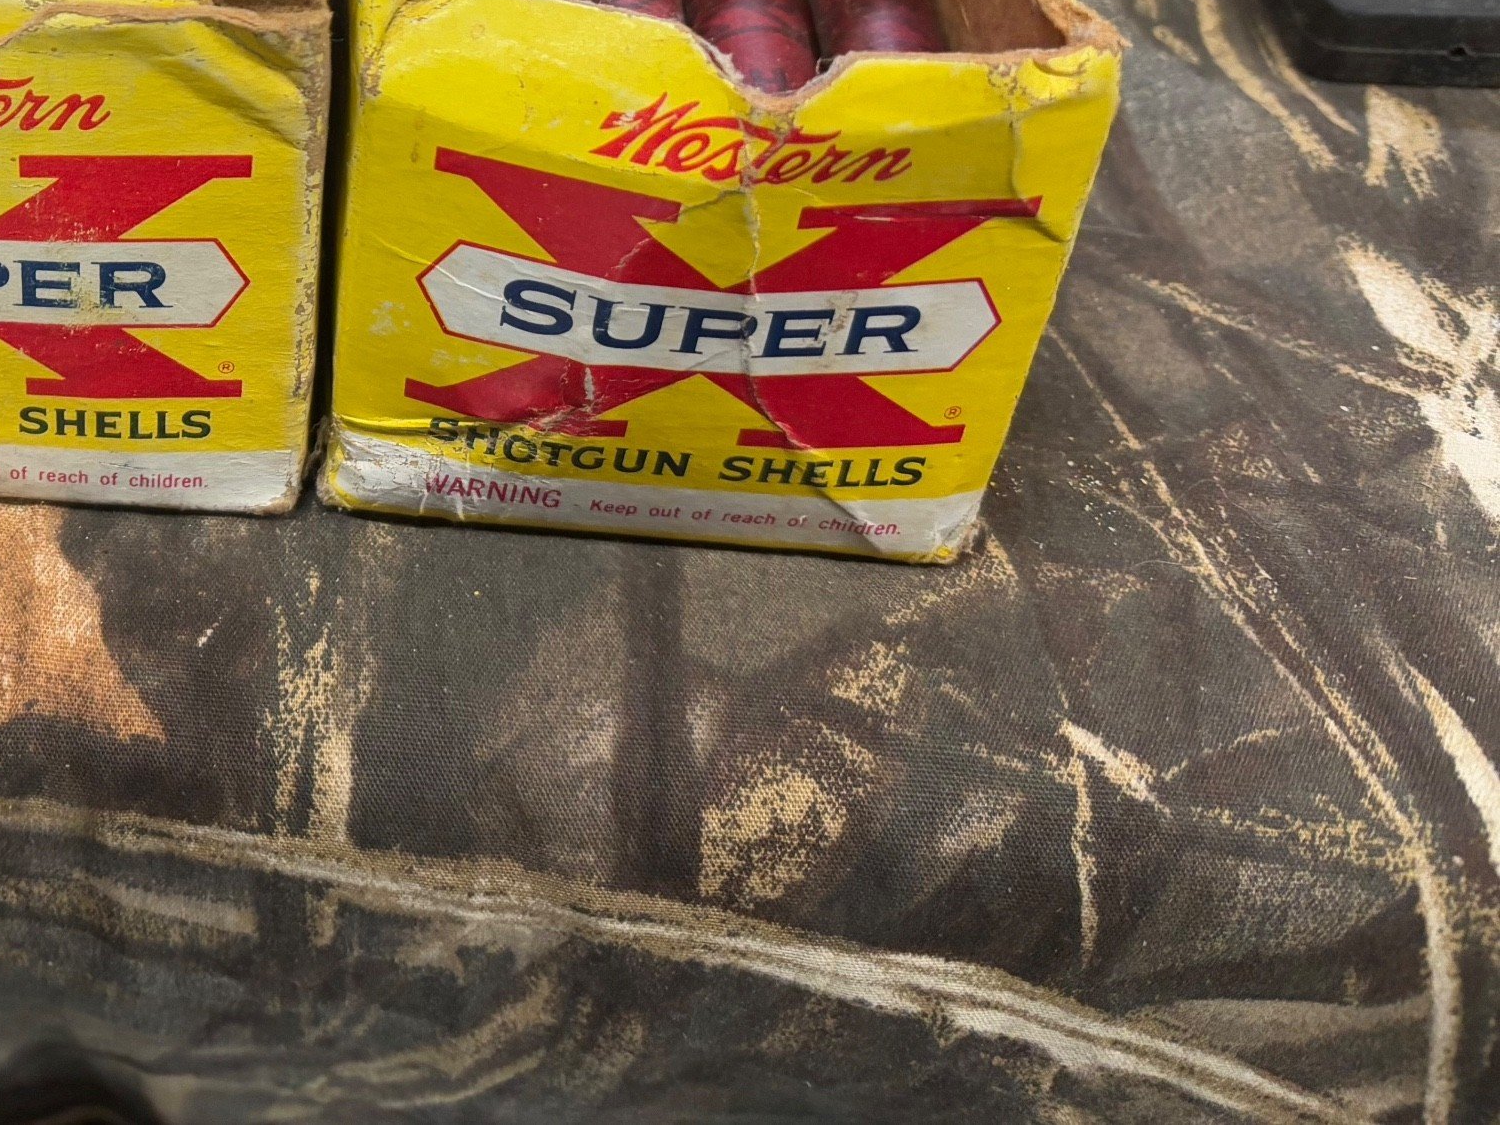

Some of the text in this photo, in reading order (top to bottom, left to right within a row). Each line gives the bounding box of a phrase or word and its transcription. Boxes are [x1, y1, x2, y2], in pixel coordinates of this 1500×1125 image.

[590, 92, 913, 185] Western
[499, 278, 921, 359] SUPER
[18, 406, 212, 440] SHELLS
[428, 417, 926, 488] SHOTGUN SHELLS
[10, 466, 28, 480] of
[38, 469, 88, 484] reach
[100, 472, 120, 486] of
[129, 474, 209, 488] children.
[426, 475, 901, 536] WARNING Keep out of reach of children.
